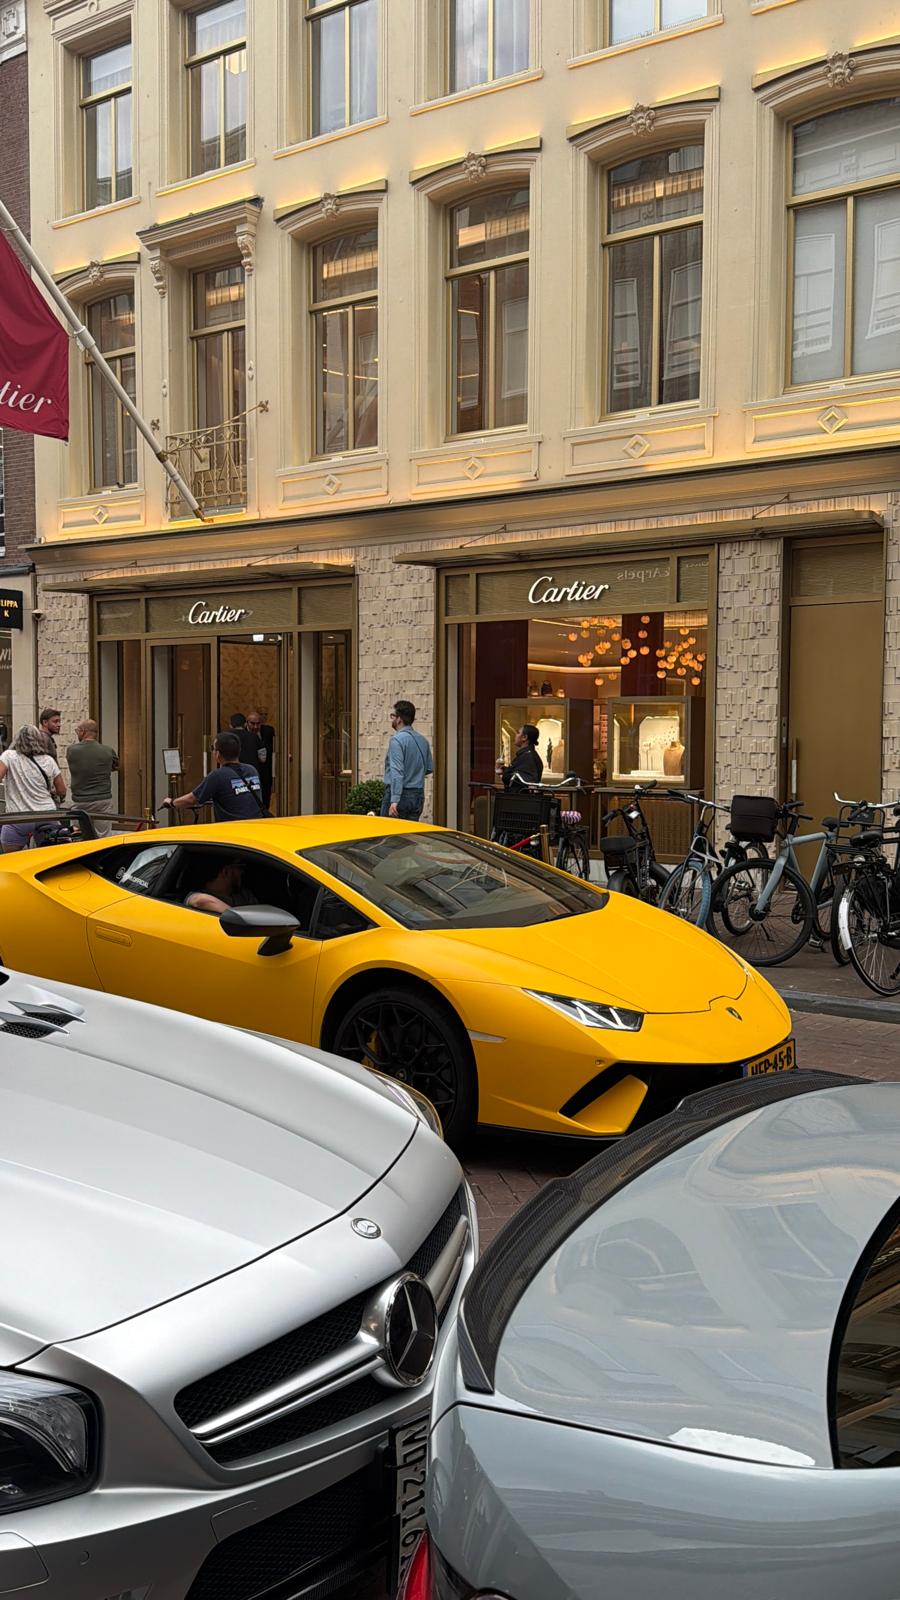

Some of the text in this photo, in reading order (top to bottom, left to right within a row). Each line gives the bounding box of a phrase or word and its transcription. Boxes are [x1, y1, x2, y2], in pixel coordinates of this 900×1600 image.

[528, 576, 609, 604] Cartier
[4, 609, 9, 617] K
[188, 601, 245, 624] Cartier
